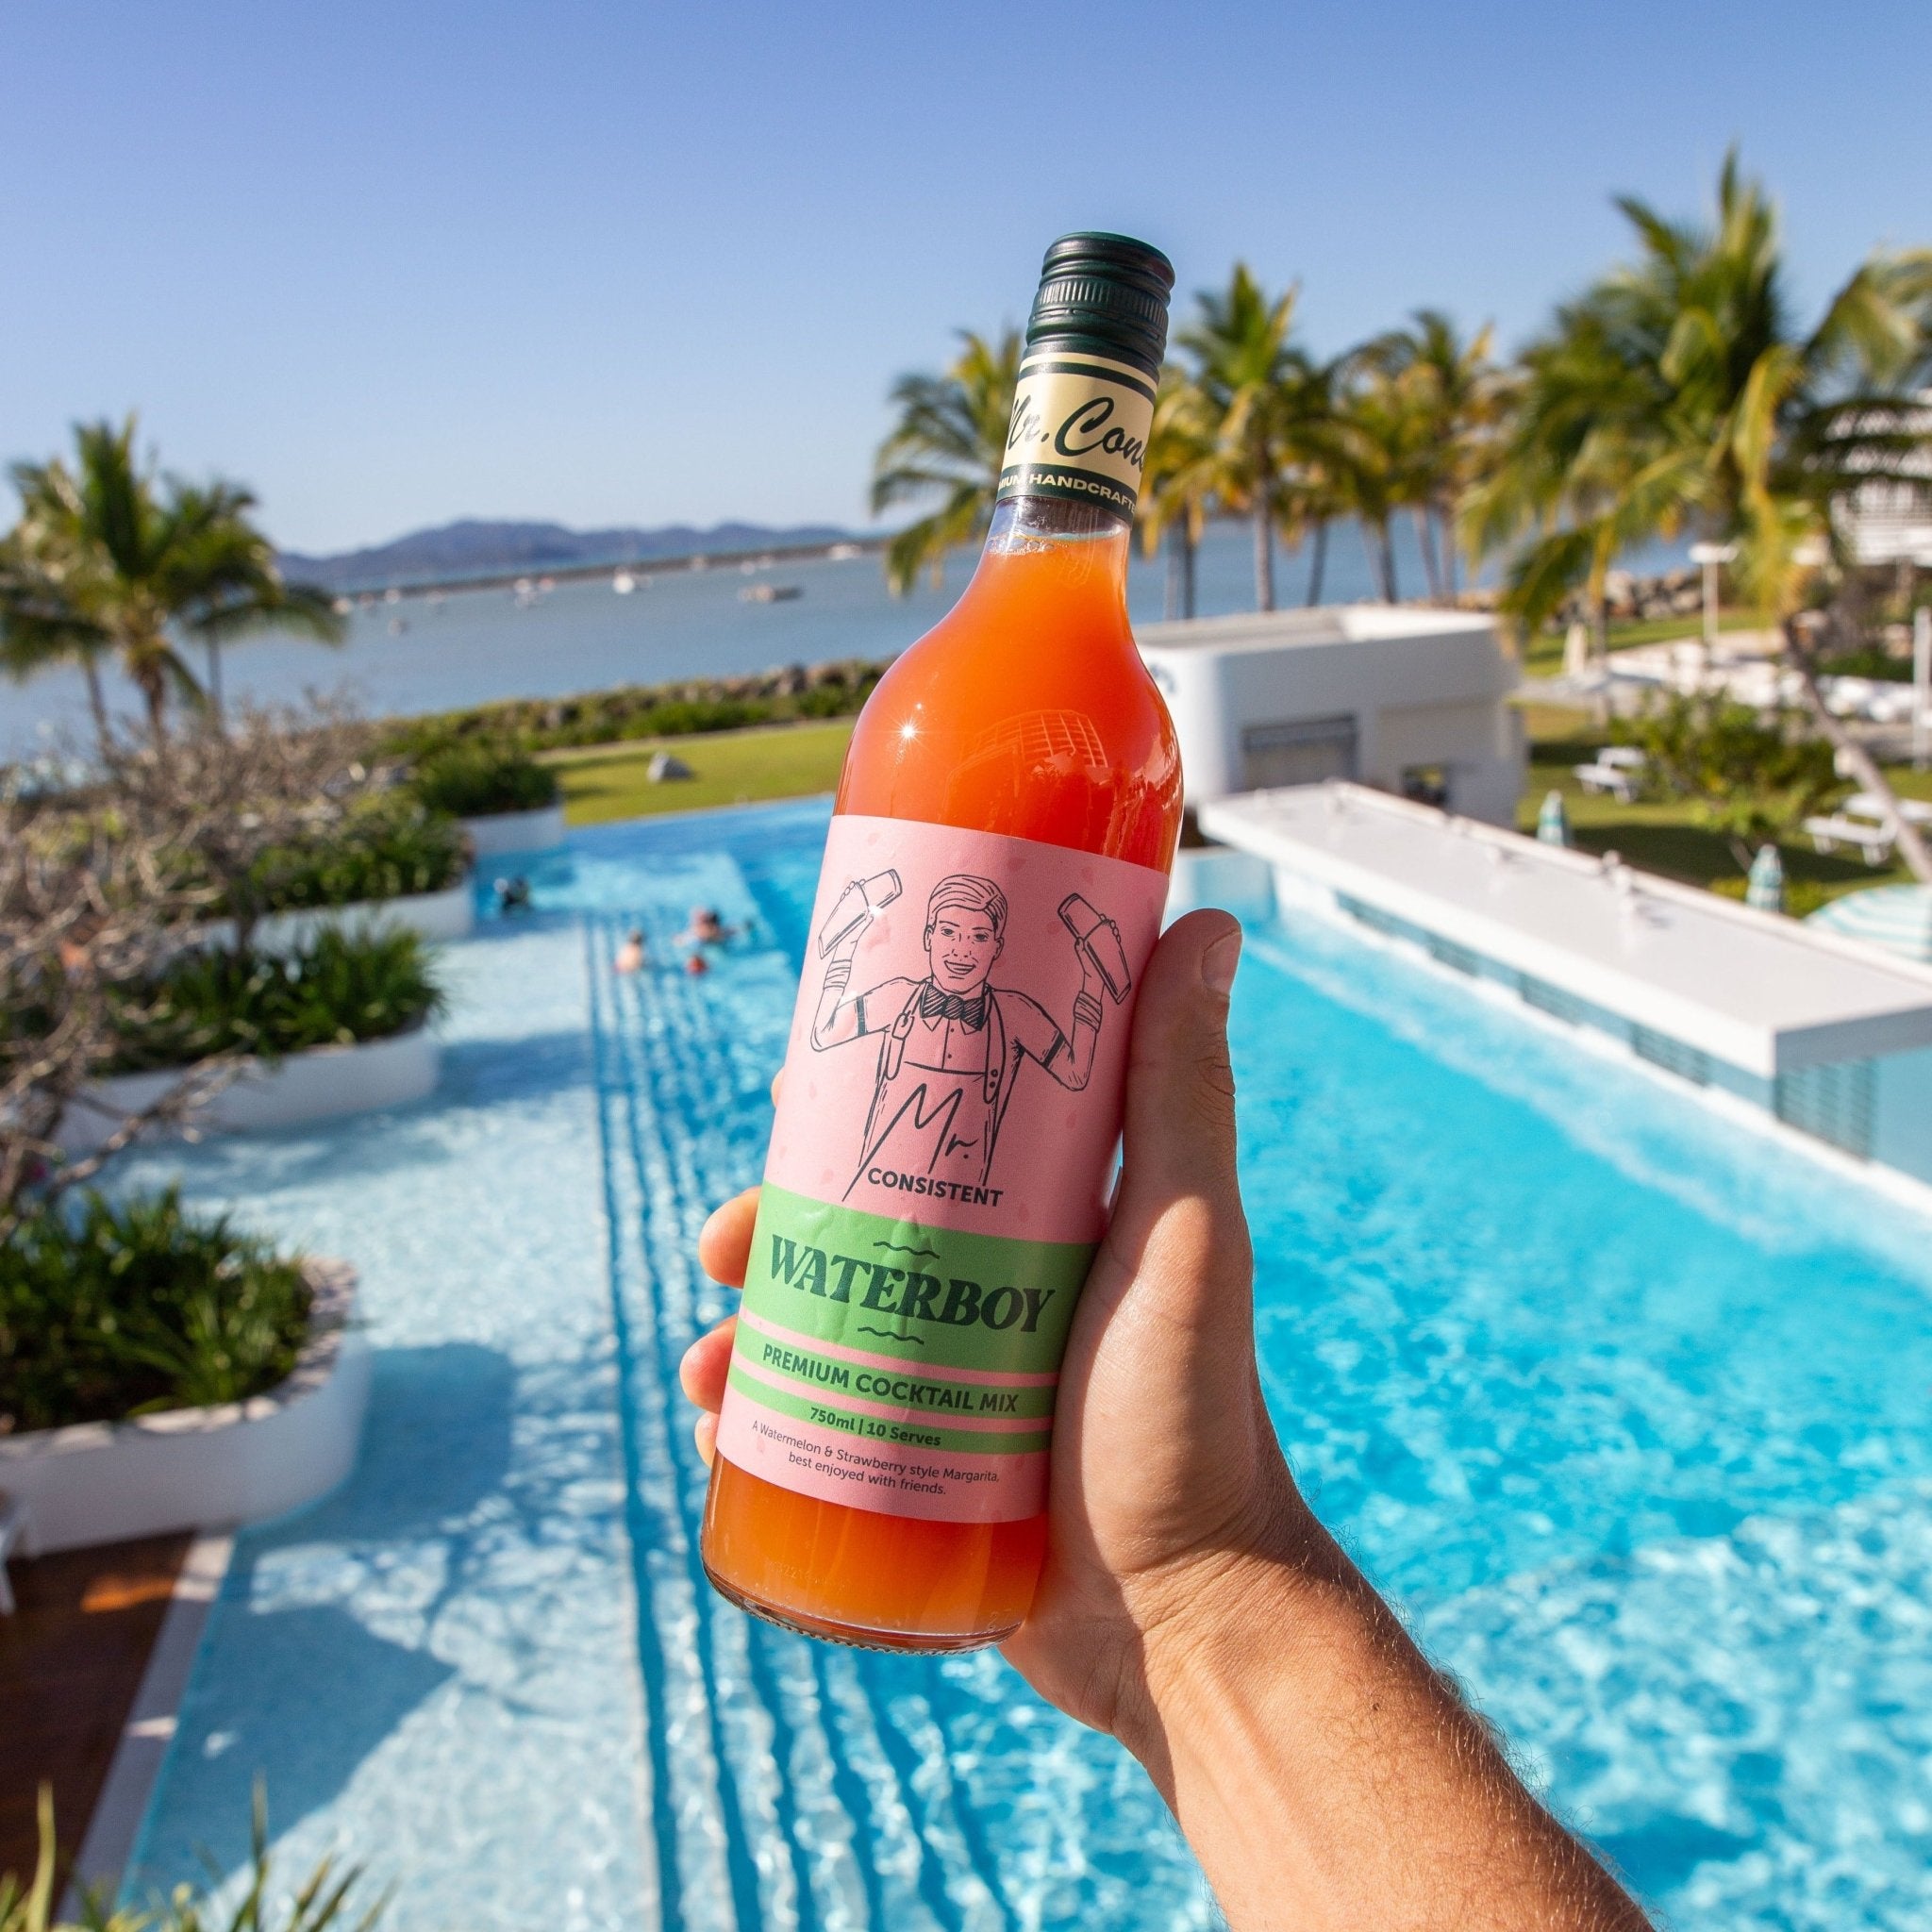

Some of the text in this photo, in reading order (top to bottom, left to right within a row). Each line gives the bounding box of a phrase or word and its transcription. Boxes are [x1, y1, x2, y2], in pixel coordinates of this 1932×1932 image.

[841, 1082, 978, 1202] Mr.
[867, 1167, 1003, 1207] CONSISTENT
[771, 1234, 1056, 1333] WATERBOY
[762, 1342, 1020, 1412] PREMIUM COCKTAIL MIX
[752, 1420, 758, 1432] A
[759, 1422, 821, 1455] Watermelon
[824, 1445, 833, 1457] &
[836, 1449, 907, 1476] Strawberry
[909, 1465, 940, 1480] style
[810, 1407, 856, 1431] 750ml
[866, 1422, 887, 1437] 10
[890, 1426, 941, 1446] Serves
[789, 1451, 946, 1495] best enjoyed with friends.
